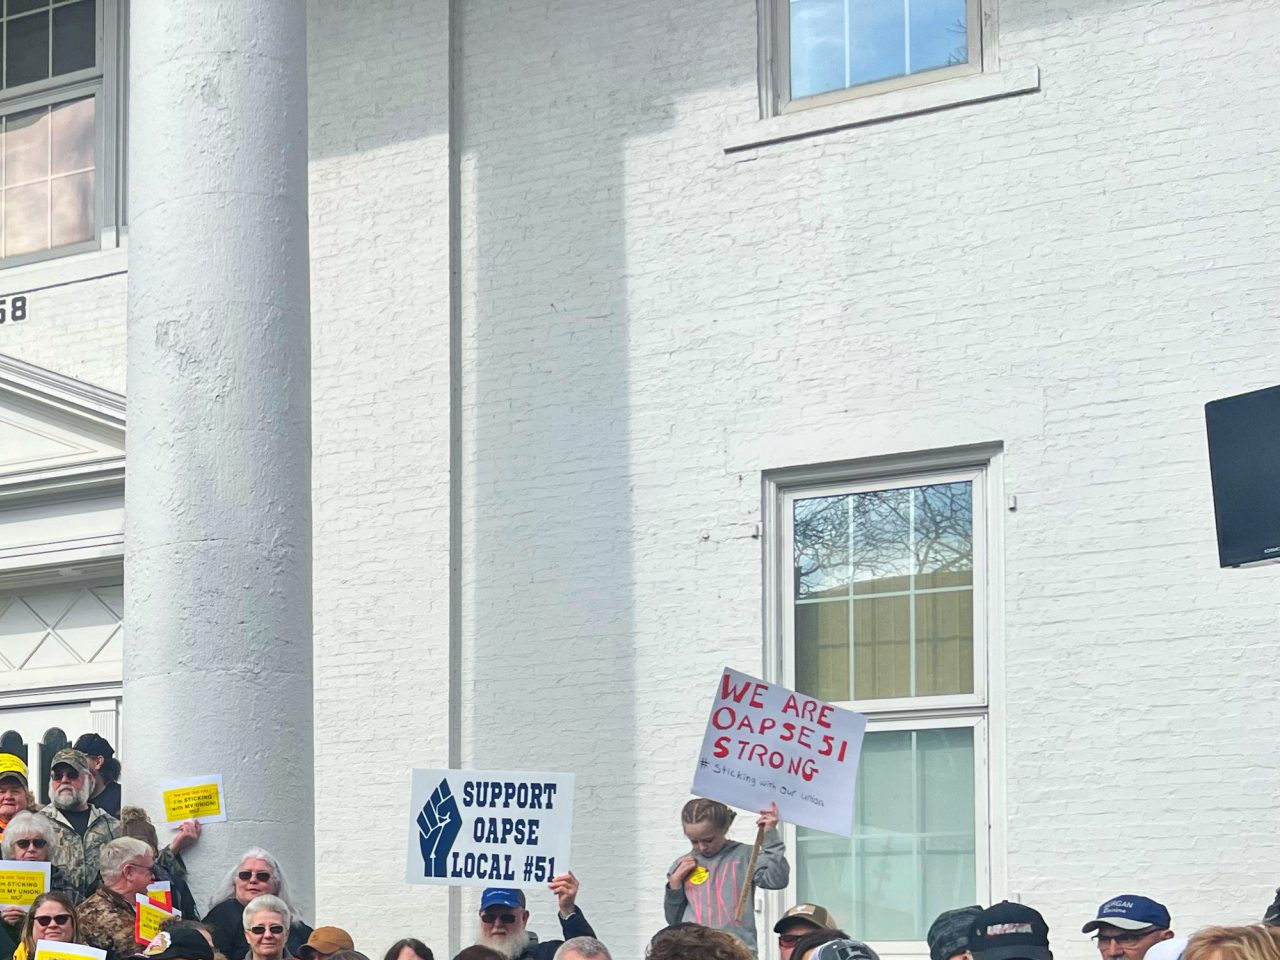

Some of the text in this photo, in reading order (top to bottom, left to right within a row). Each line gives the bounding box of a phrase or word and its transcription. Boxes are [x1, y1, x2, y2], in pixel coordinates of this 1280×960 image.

[721, 674, 834, 728] WE ARE
[713, 736, 819, 782] STRONG
[184, 794, 212, 803] STICKING
[463, 781, 556, 809] SUPPORT
[473, 816, 540, 845] OAPSE
[451, 852, 555, 882] LOCAL #51
